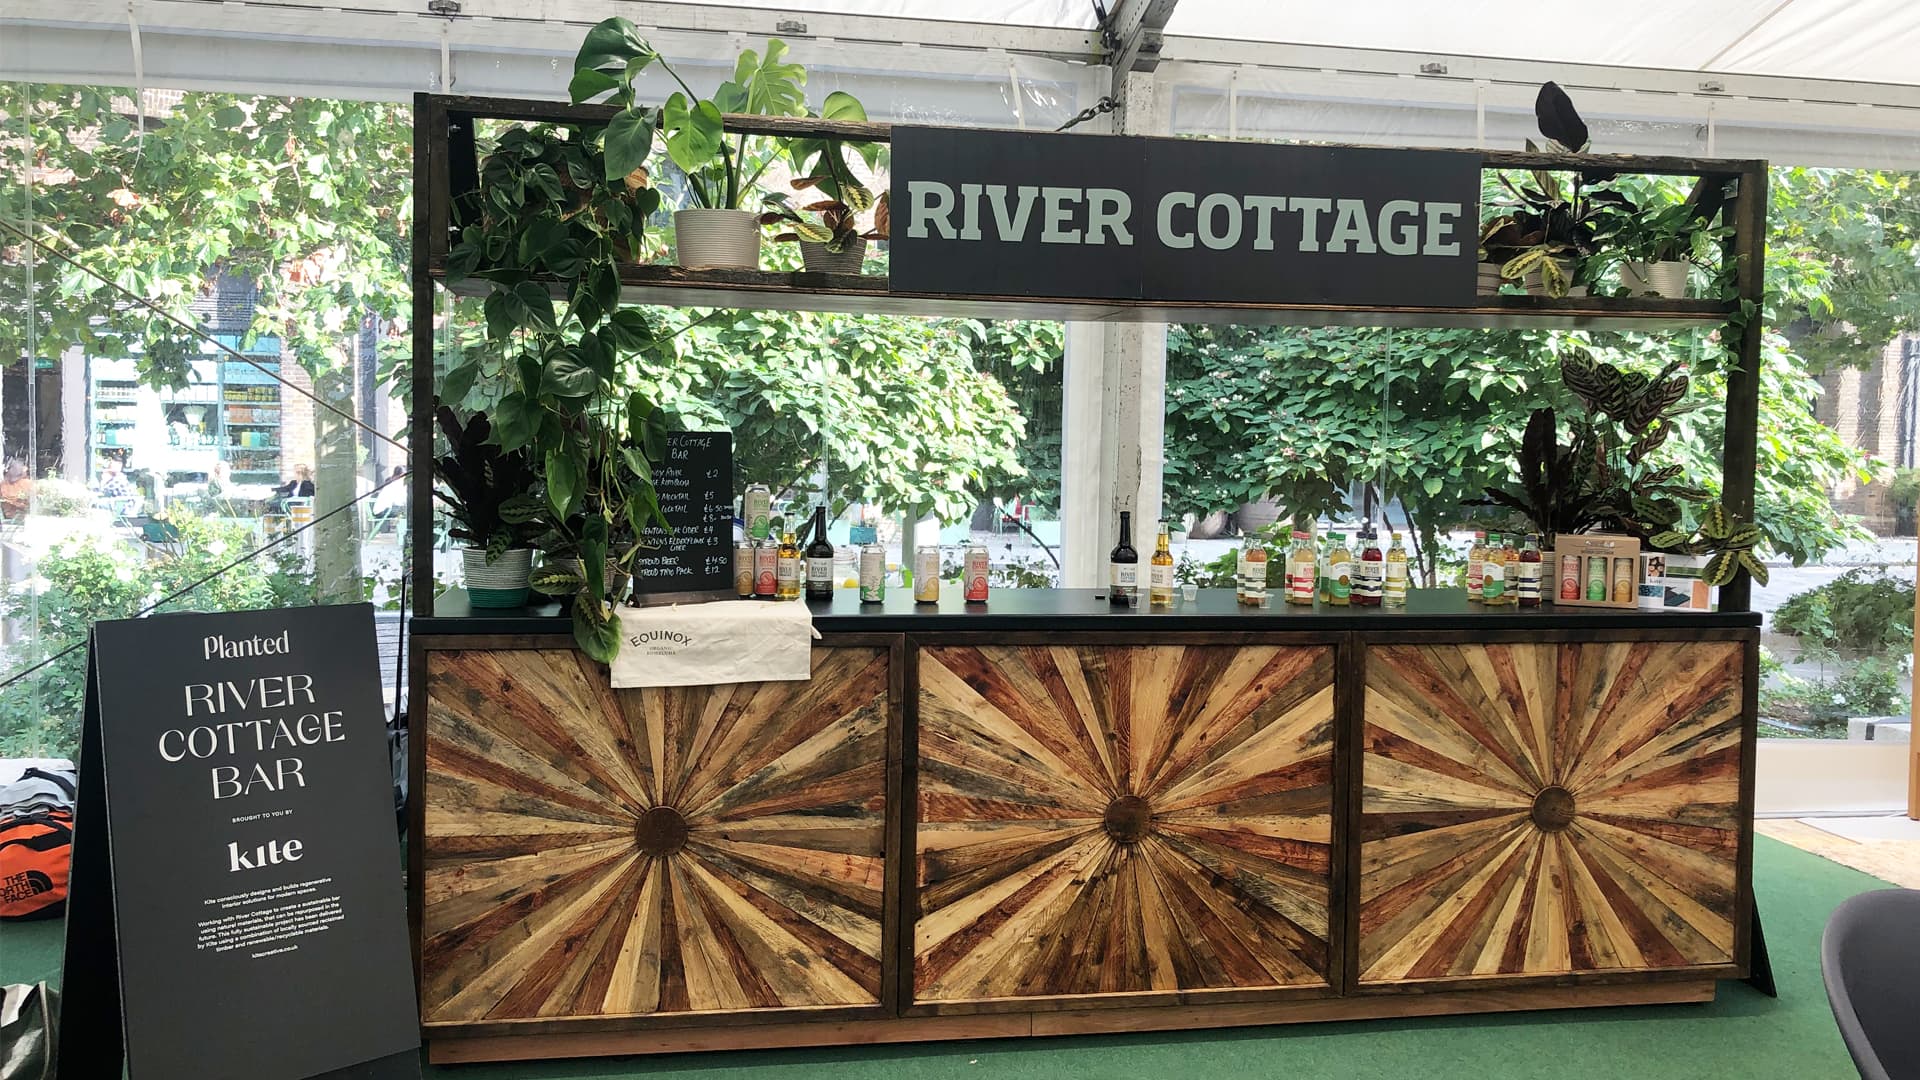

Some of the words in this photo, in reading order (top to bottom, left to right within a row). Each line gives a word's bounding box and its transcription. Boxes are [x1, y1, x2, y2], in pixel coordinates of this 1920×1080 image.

[907, 181, 1134, 245] RIVER
[1156, 191, 1461, 256] COTTAGE
[680, 435, 712, 450] COTTAGE
[671, 447, 689, 460] BAR
[706, 468, 719, 478] £2
[704, 490, 715, 500] £5
[706, 536, 719, 546] £3
[704, 566, 720, 575] £12
[203, 630, 289, 660] Planted
[630, 631, 692, 647] EQUINOX
[184, 674, 316, 716] RIVER
[158, 711, 345, 762] COTTAGE
[211, 757, 306, 799] BAR
[232, 814, 260, 824] BROUGHT
[228, 839, 303, 872] kite
[3, 871, 27, 886] THE
[0, 882, 31, 897] ORTH
[4, 889, 34, 904] FACE
[198, 919, 221, 927] Working
[251, 909, 272, 917] Cottage
